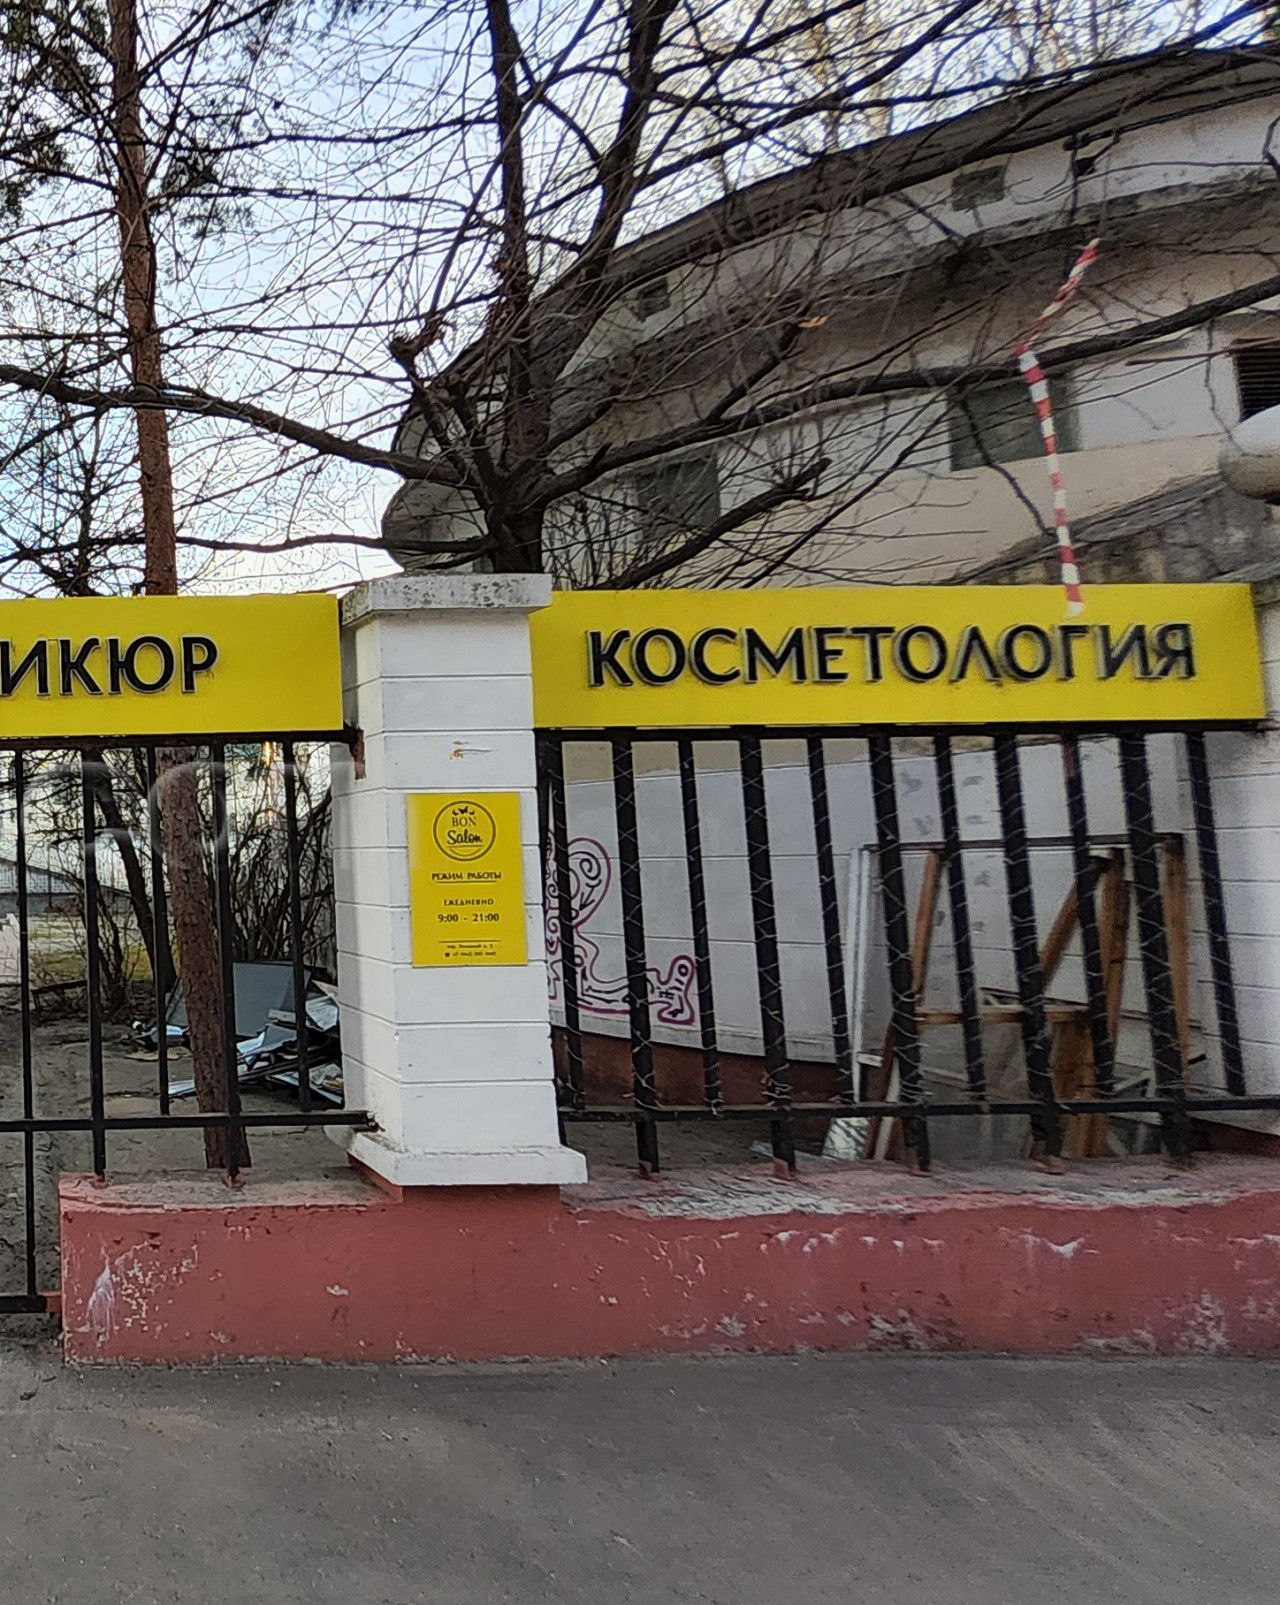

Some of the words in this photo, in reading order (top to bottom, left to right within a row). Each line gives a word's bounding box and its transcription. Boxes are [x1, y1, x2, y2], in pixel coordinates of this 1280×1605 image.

[587, 622, 1197, 688] КОСМЕТОЛОГИЯ
[451, 816, 477, 827] BON
[447, 829, 483, 845] Salon
[431, 872, 463, 880] РЕЖИМ
[467, 872, 502, 880] РАБОТЫ
[443, 898, 495, 907] ЕЖЕДНЕВНО
[437, 913, 459, 923] 9:00
[472, 913, 500, 923] 21:00
